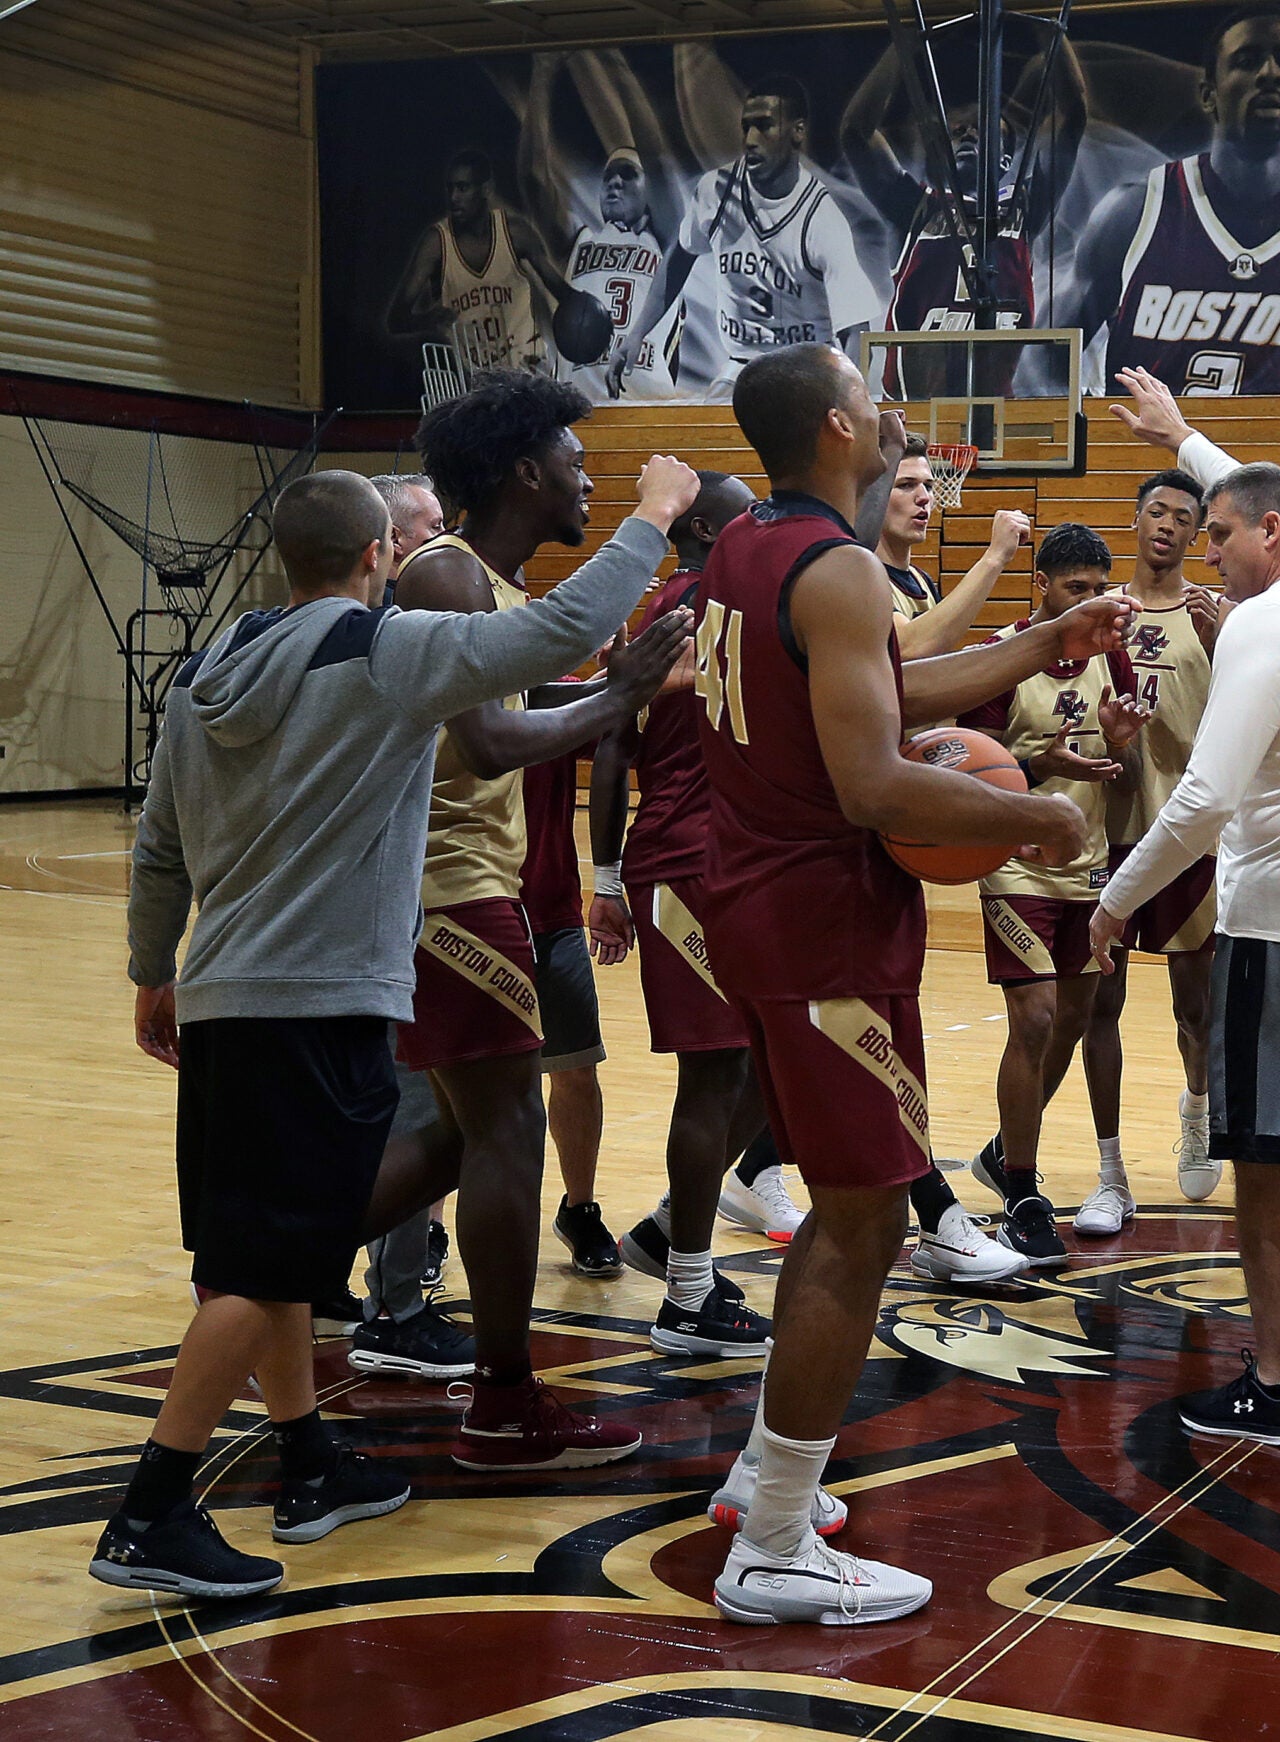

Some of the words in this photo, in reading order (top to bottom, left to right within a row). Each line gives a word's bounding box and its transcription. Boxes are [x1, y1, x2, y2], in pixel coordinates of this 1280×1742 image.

[719, 251, 804, 298] BOSTON
[605, 277, 635, 329] 3
[695, 598, 749, 745] 41
[997, 914, 1036, 955] COLLEGE
[430, 926, 494, 977] BOSTON
[488, 966, 538, 1017] COLLEGE
[896, 1078, 930, 1137] COLLEGE
